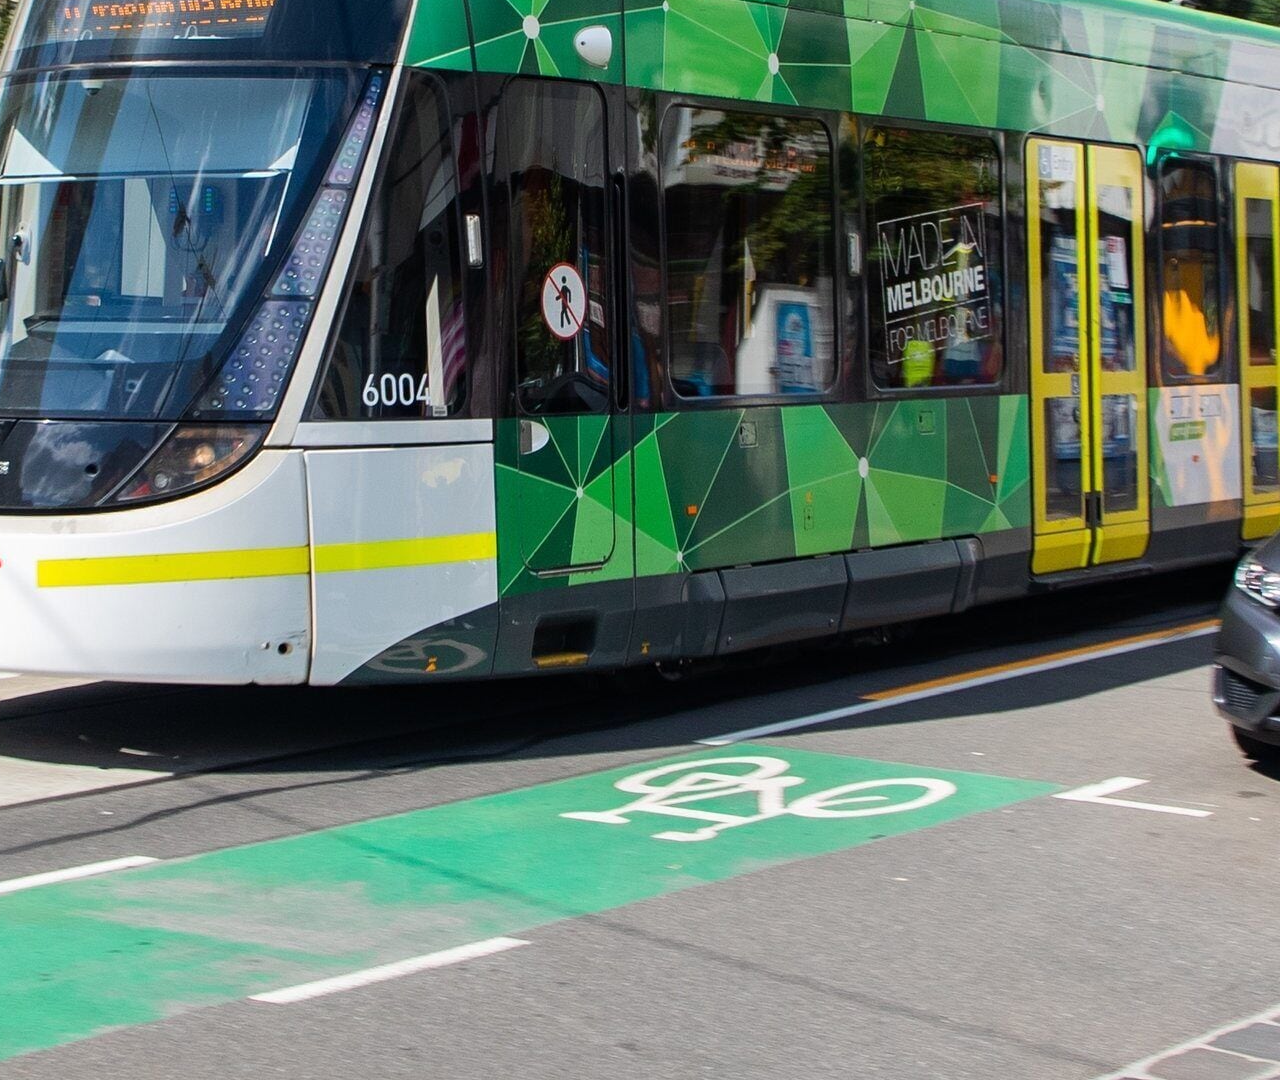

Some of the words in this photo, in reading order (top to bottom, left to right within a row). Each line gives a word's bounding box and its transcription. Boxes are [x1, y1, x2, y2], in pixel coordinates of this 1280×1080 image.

[882, 218, 957, 280] MADE
[886, 265, 985, 314] MELBOURNE
[362, 373, 431, 407] 6004
